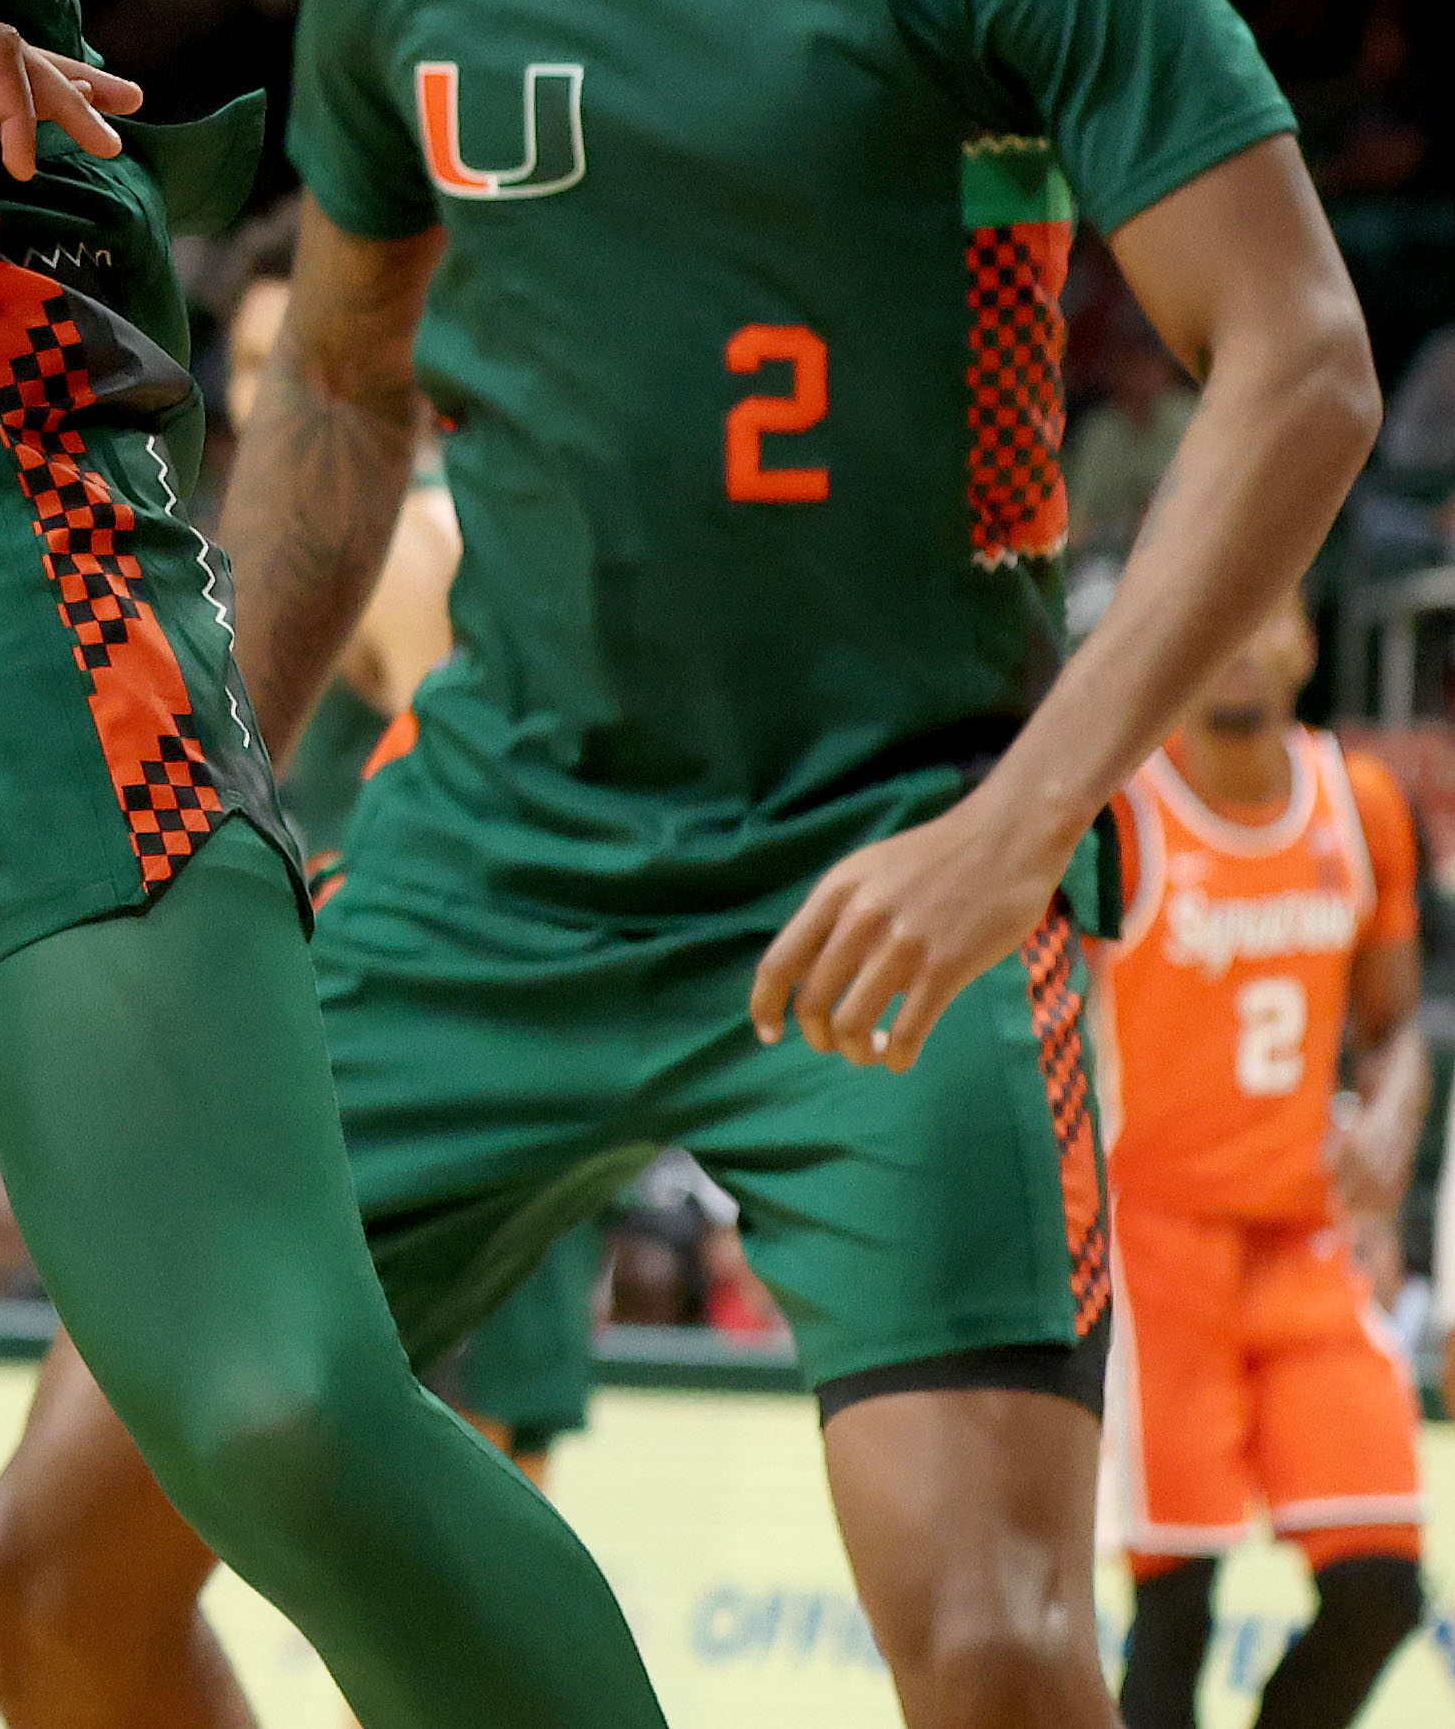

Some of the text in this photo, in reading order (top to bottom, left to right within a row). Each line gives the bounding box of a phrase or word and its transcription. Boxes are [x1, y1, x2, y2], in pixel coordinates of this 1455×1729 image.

[415, 60, 585, 201] U
[725, 323, 830, 503] 2
[1235, 978, 1308, 1096] 2
